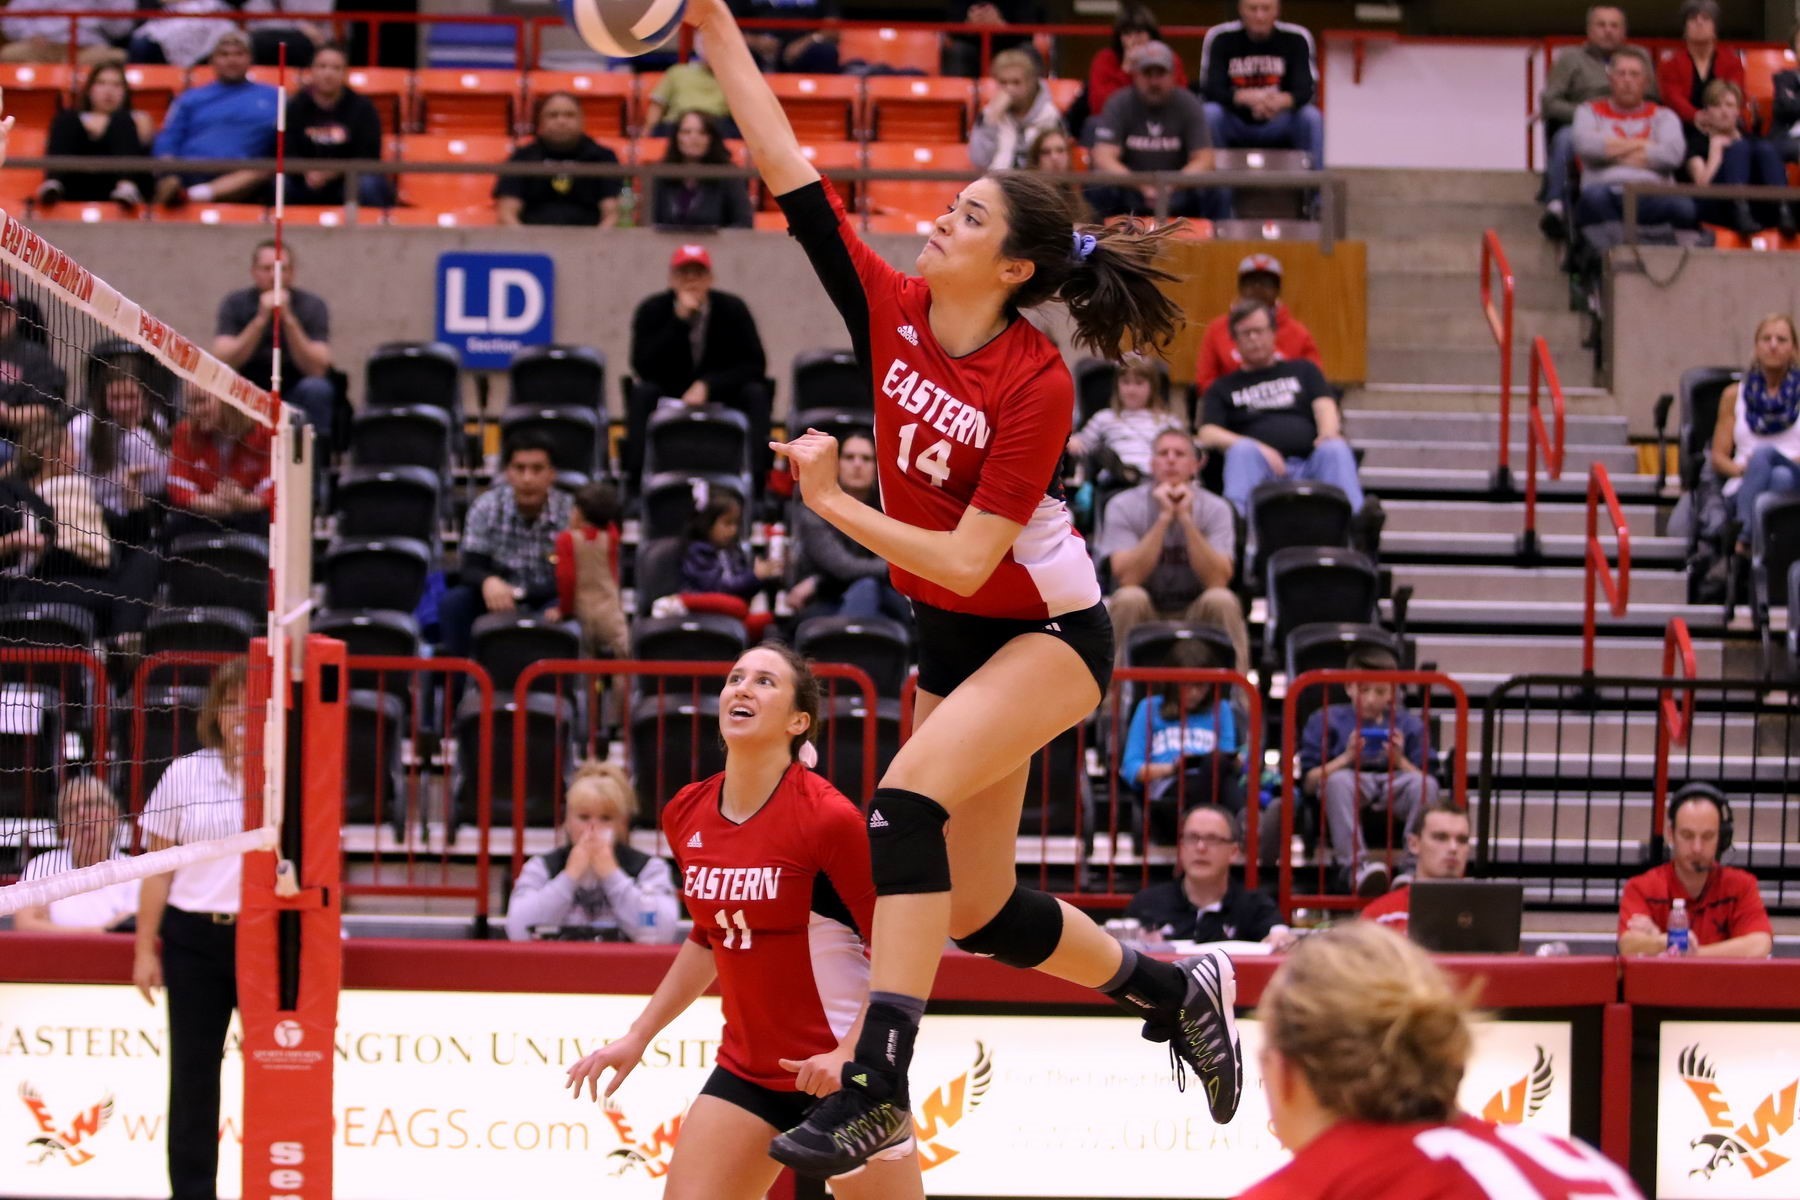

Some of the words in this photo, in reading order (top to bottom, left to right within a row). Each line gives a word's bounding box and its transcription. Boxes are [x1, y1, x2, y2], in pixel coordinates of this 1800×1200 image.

[445, 266, 546, 335] LD
[897, 326, 919, 346] adidas
[882, 358, 991, 449] EASTERN
[897, 423, 952, 487] 14
[684, 865, 782, 900] EASTERN
[714, 909, 752, 950] 11
[0, 1023, 166, 1058] ASTERN
[269, 1141, 305, 1200] se
